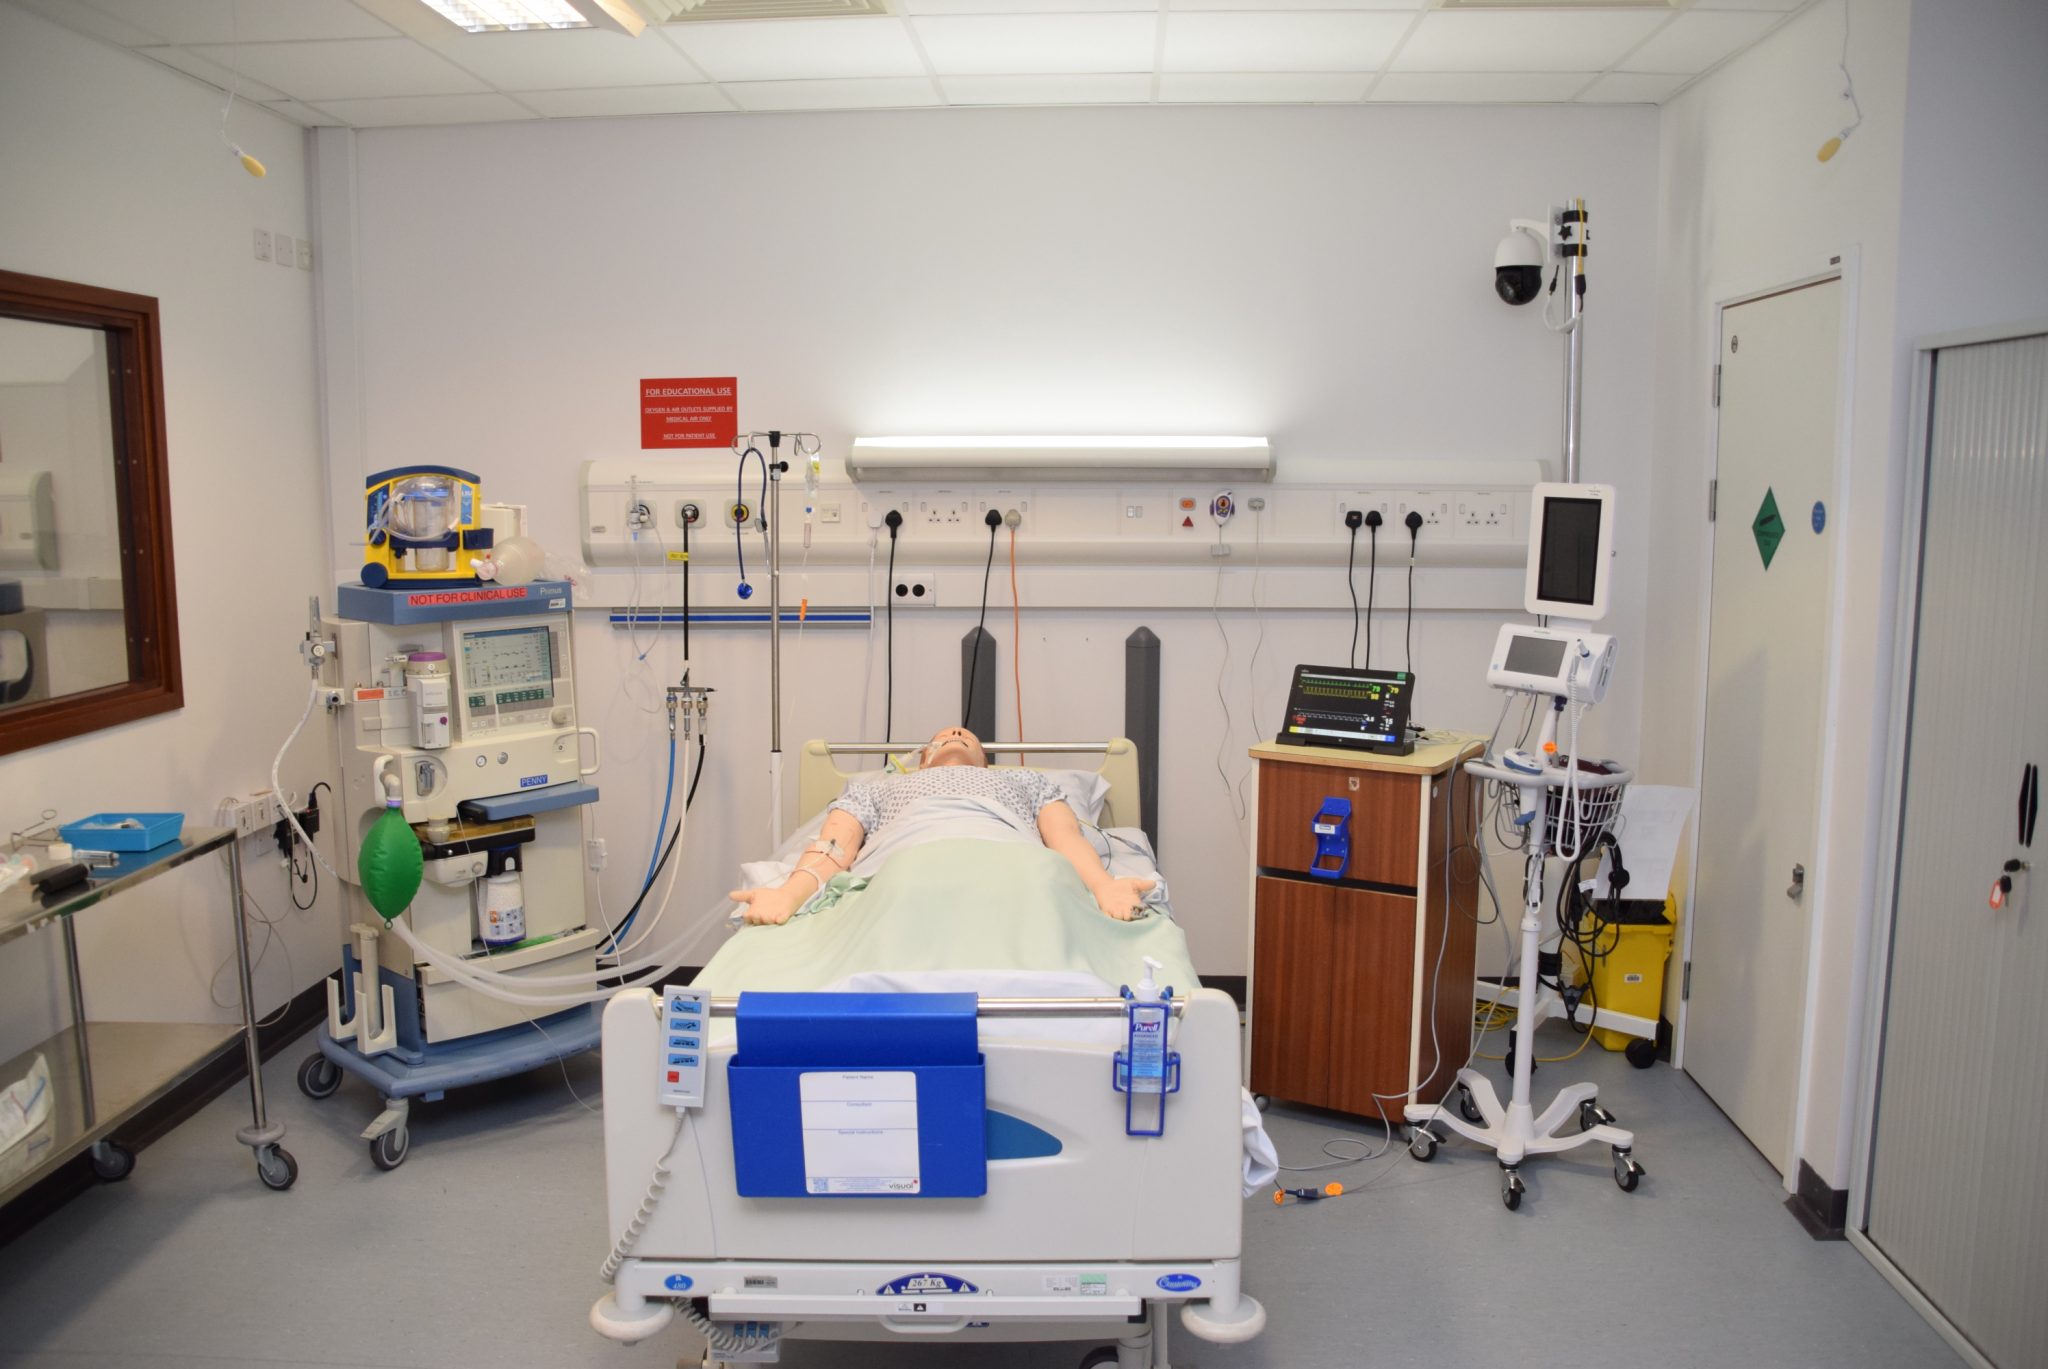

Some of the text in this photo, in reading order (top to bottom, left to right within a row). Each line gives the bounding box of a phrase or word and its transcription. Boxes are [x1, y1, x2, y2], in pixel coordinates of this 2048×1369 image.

[645, 386, 732, 397] FOR EDUCATIONAL USE
[410, 588, 526, 606] NOT FOR CLINICAL USE
[521, 775, 547, 787] PENNY
[912, 1279, 942, 1288] 267 Kg
